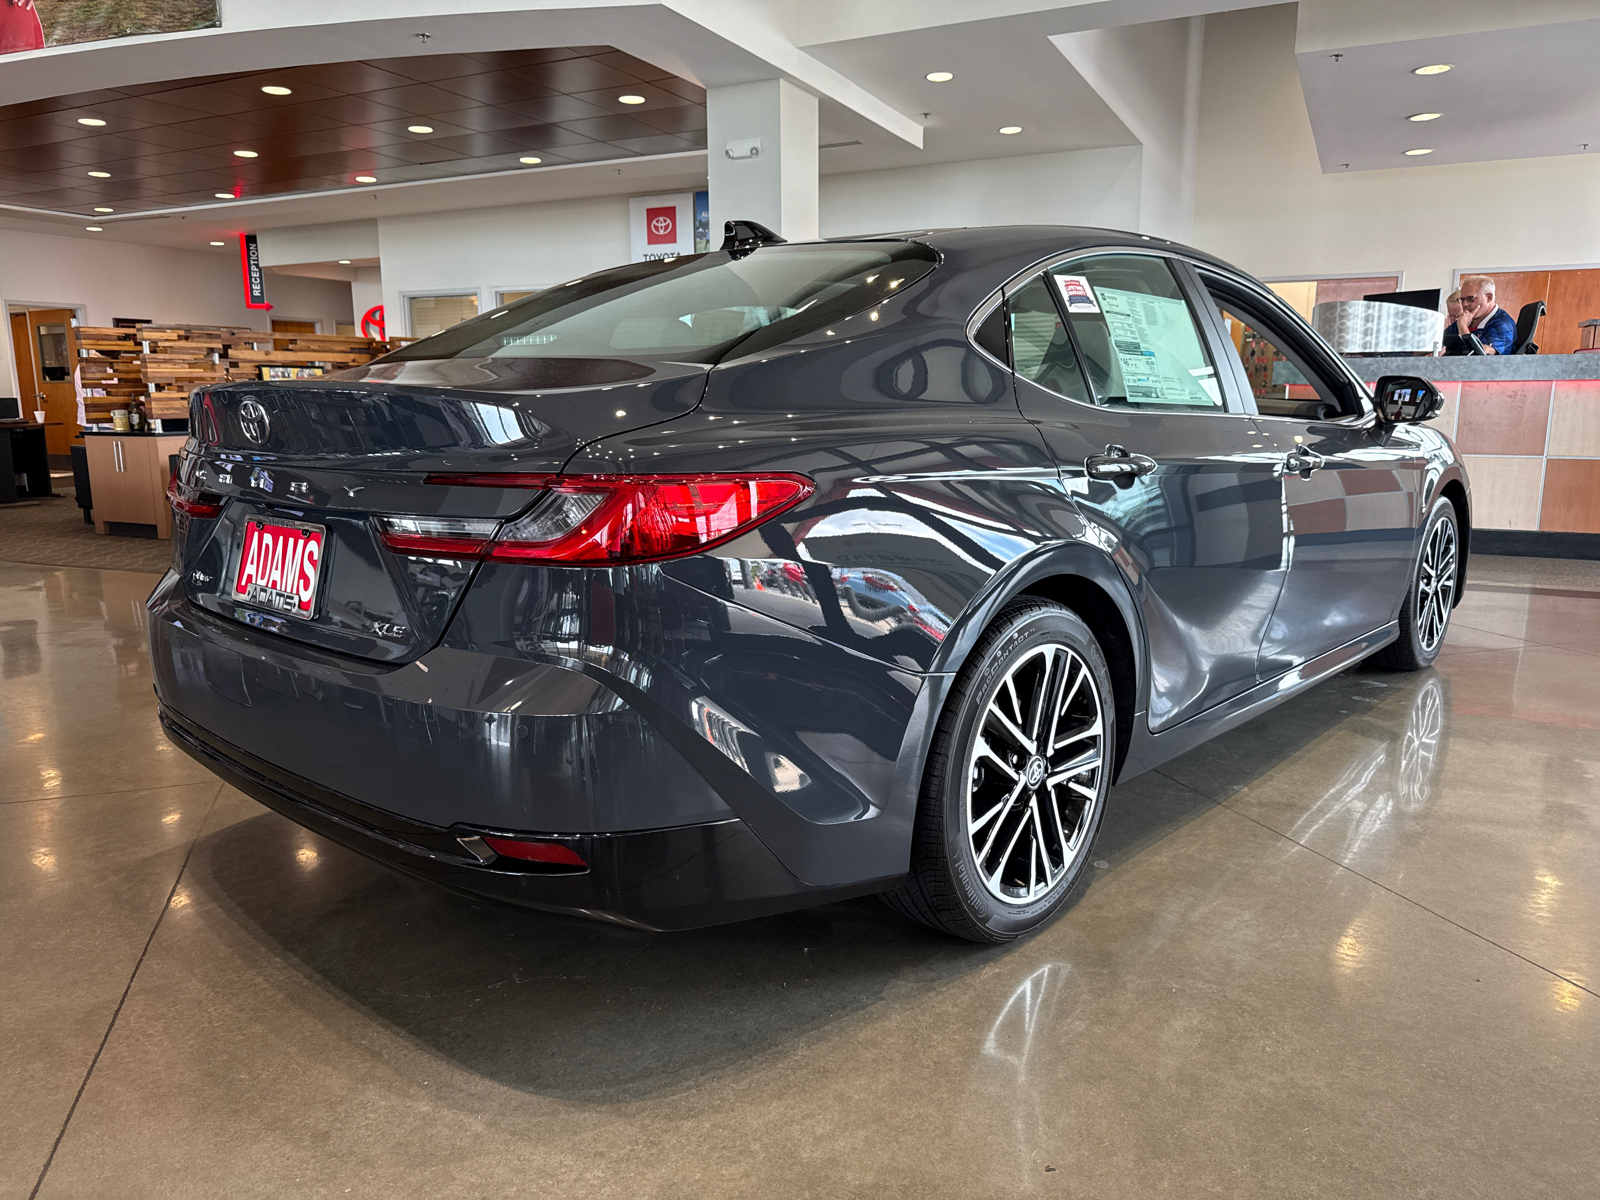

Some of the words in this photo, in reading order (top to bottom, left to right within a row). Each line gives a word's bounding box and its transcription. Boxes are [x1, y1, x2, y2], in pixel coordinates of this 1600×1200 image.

[249, 243, 261, 297] RECEPTION
[241, 531, 319, 602] ADAMS
[249, 586, 294, 612] ADAMS
[369, 621, 406, 638] XLE
